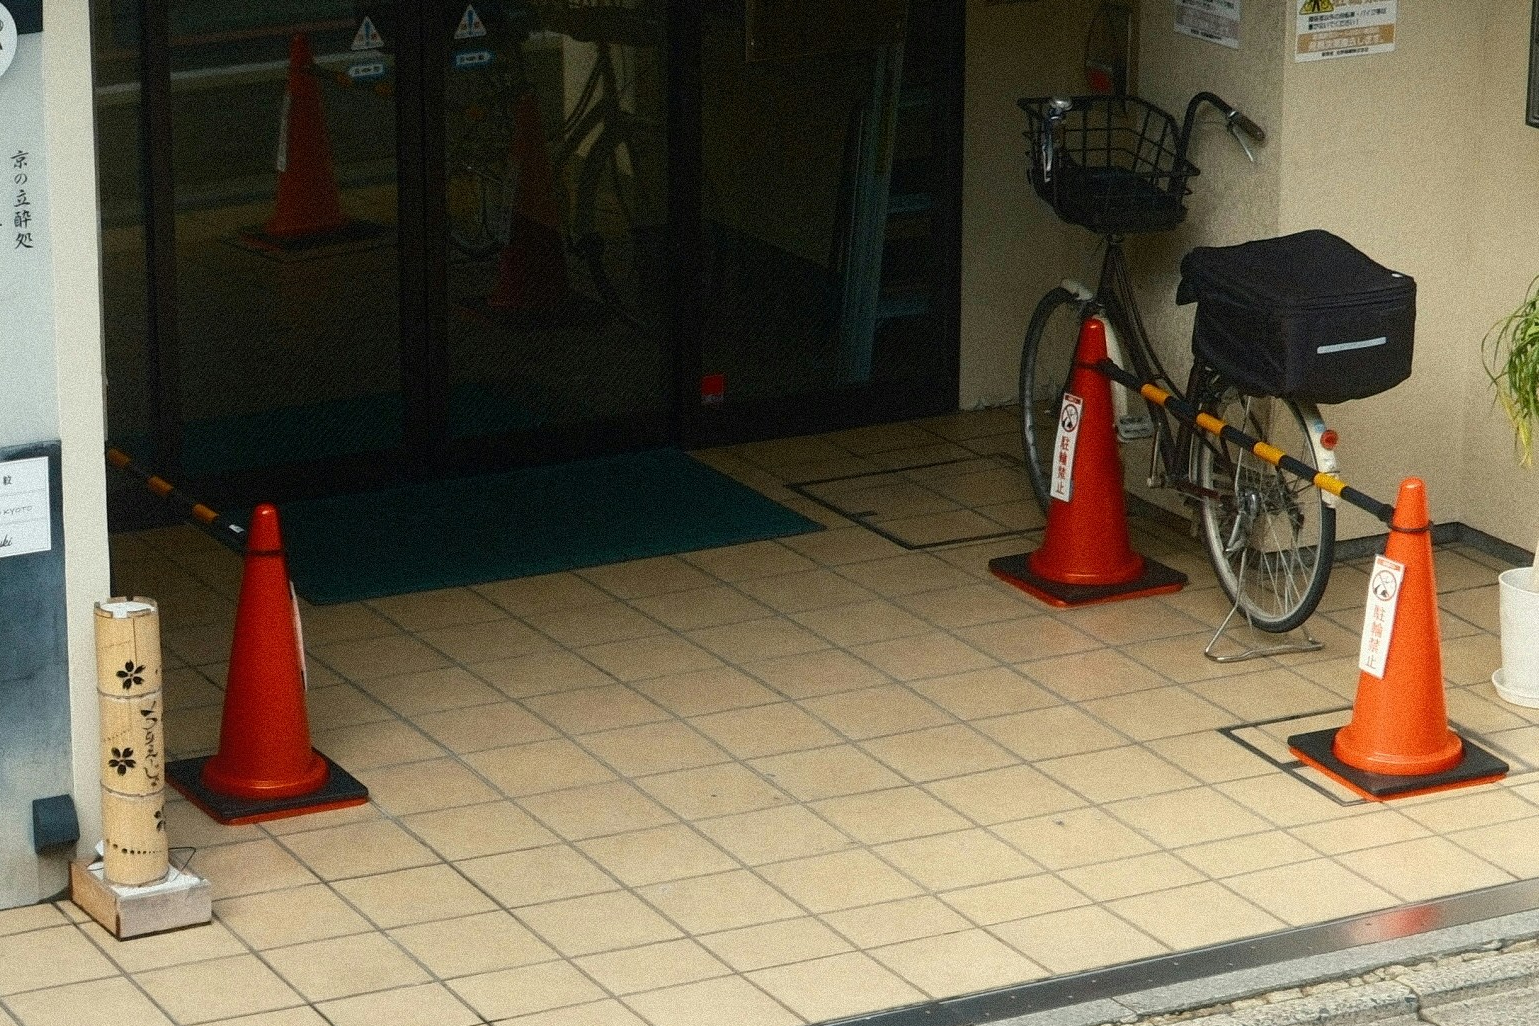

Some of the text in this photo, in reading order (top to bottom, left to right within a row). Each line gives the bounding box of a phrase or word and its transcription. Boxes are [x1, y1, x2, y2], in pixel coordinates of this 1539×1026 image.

[11, 150, 34, 250] 京の立酔処
[1055, 436, 1070, 495] 駐輪禁止
[3, 505, 33, 515] KYOTO
[1365, 605, 1387, 669] 駐輪禁止
